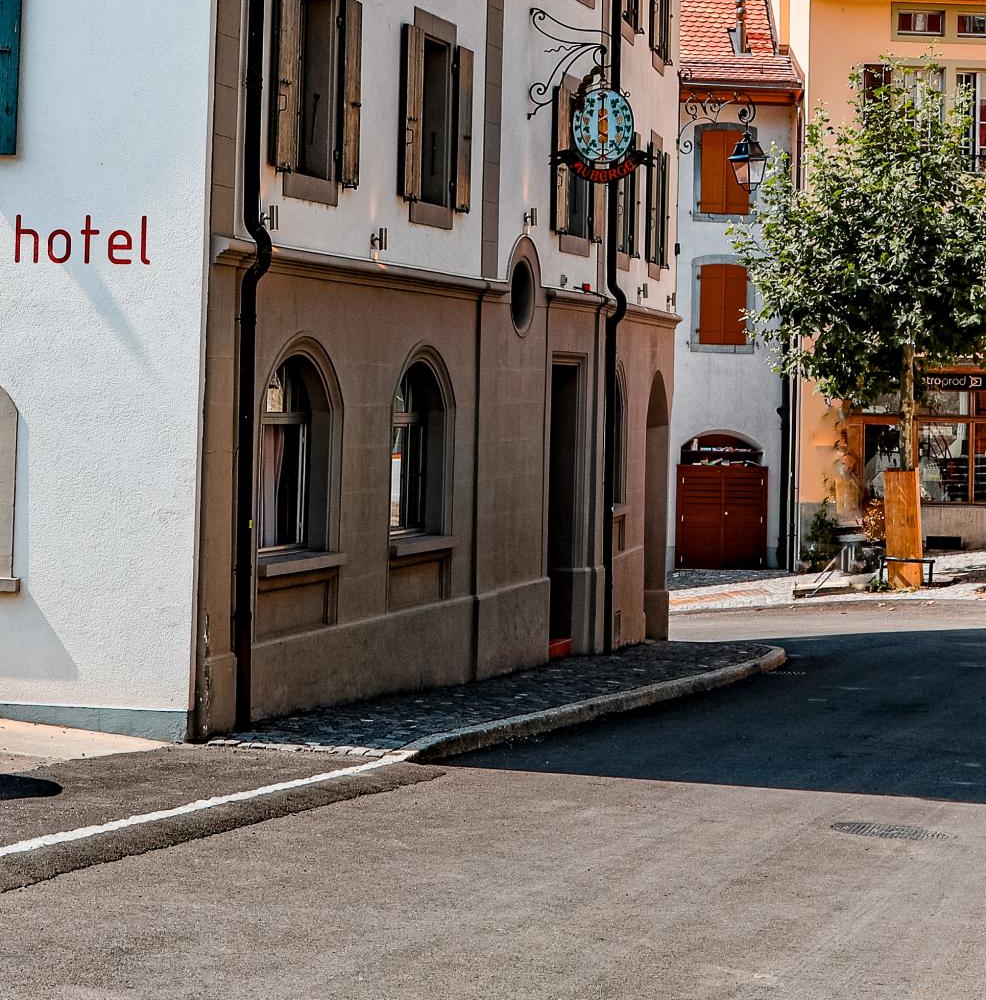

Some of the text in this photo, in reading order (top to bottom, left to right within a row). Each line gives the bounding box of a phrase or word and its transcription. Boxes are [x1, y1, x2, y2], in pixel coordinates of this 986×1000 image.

[572, 159, 636, 182] AUBERGE
[14, 214, 151, 265] hotel
[921, 376, 967, 388] etroprod
